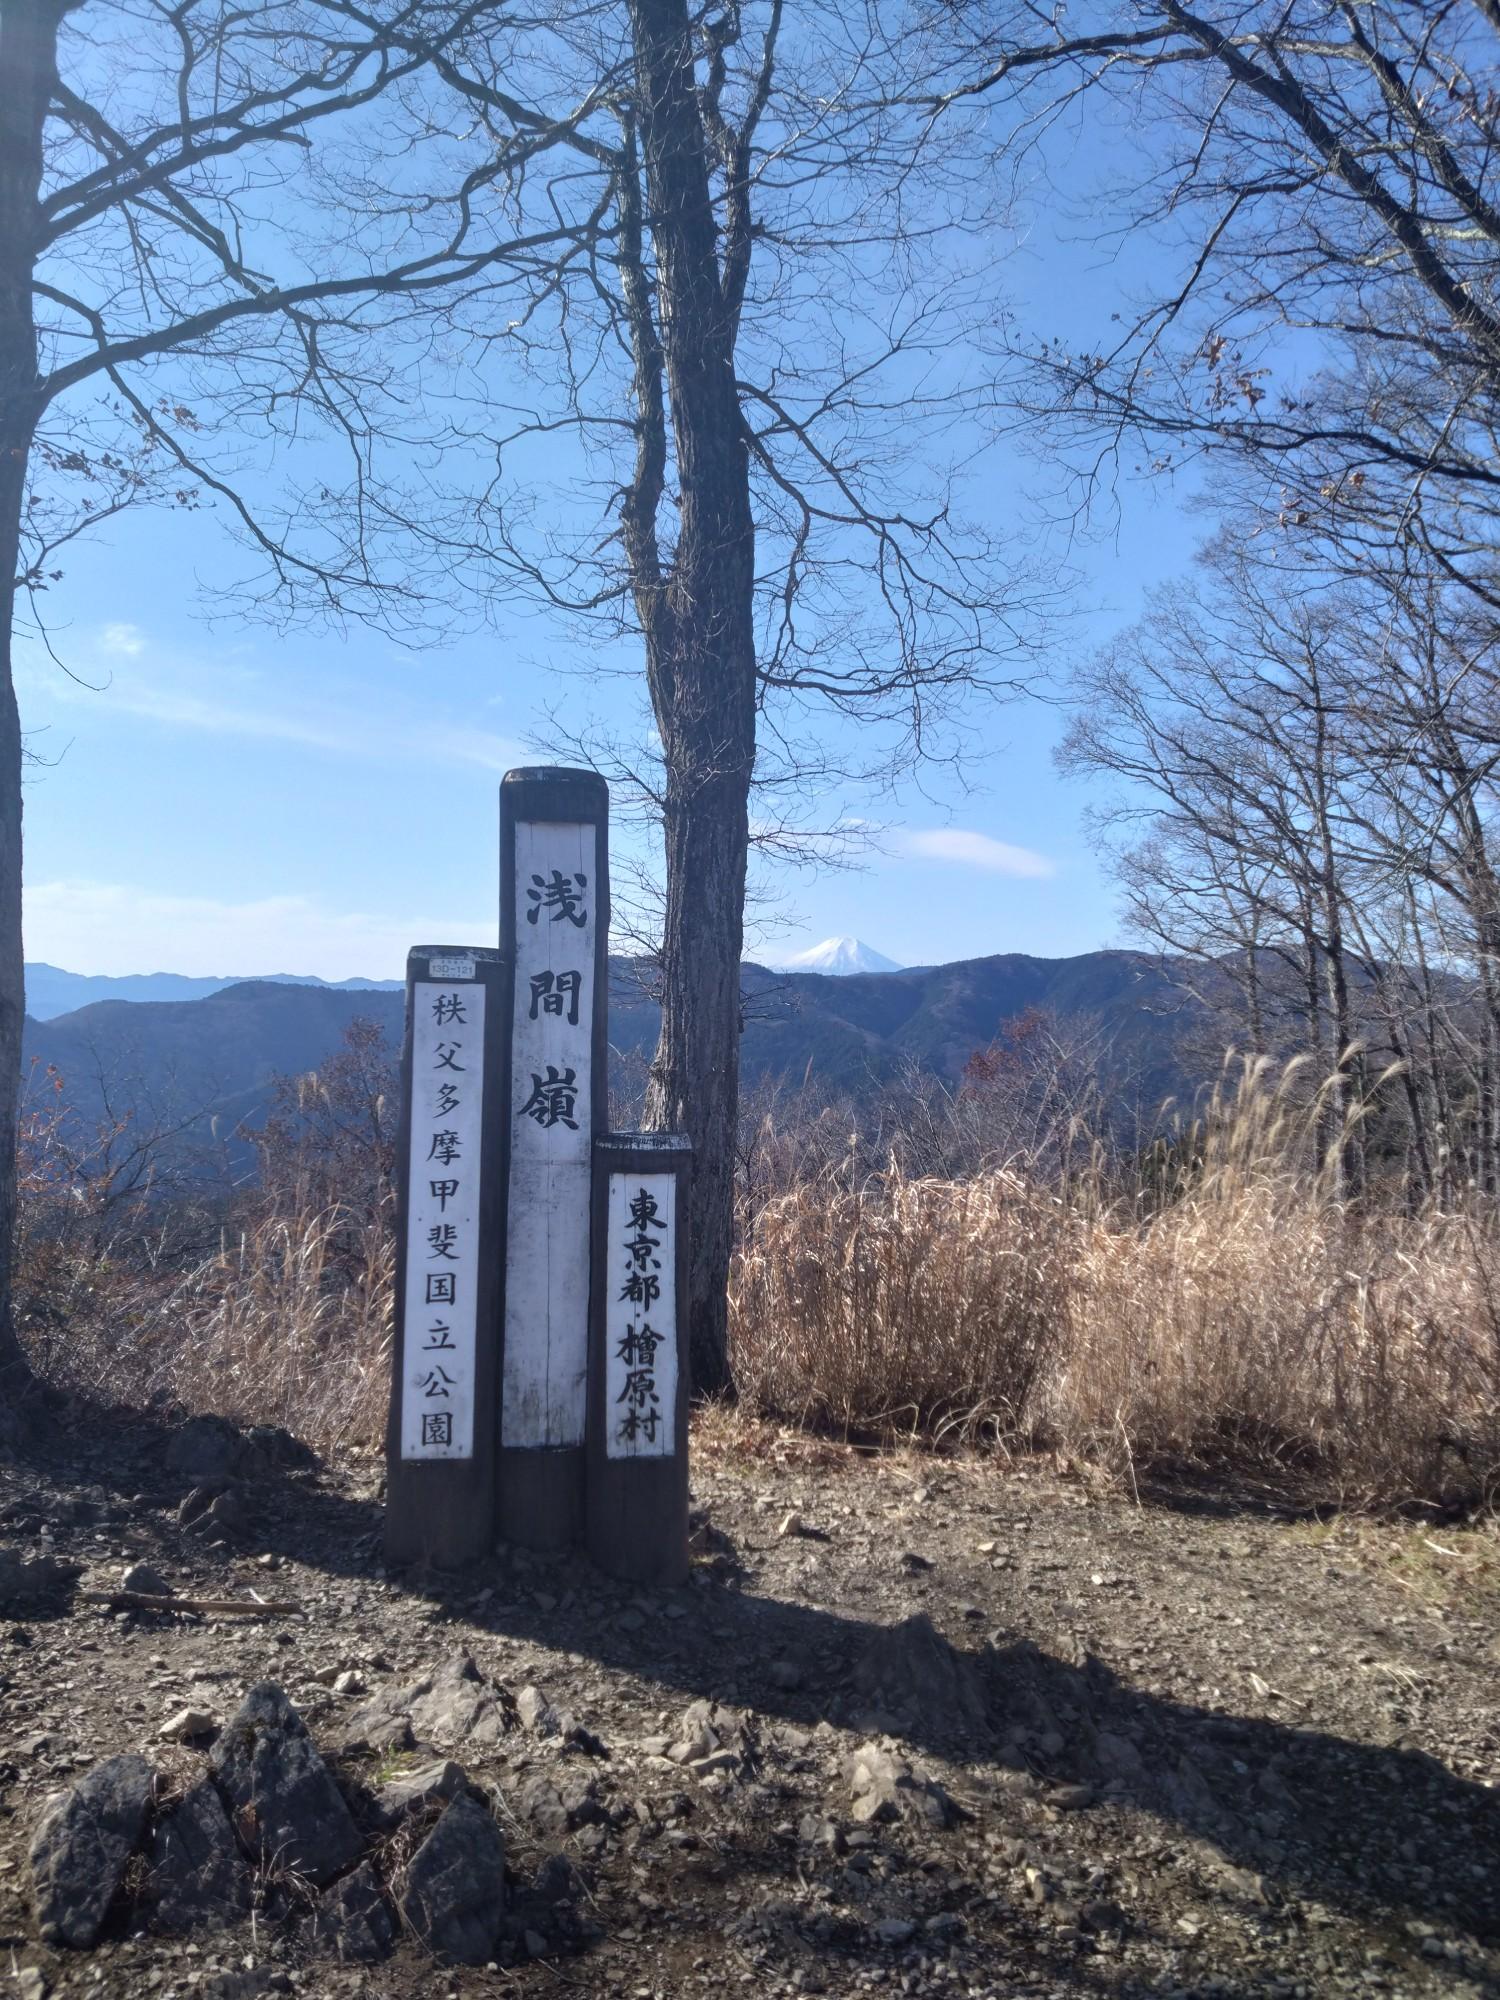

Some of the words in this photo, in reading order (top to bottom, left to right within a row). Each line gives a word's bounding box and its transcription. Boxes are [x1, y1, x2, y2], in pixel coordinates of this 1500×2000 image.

[517, 869, 588, 1131] 浅間嶺
[420, 992, 468, 1447] 秩父多摩甲斐国立公園
